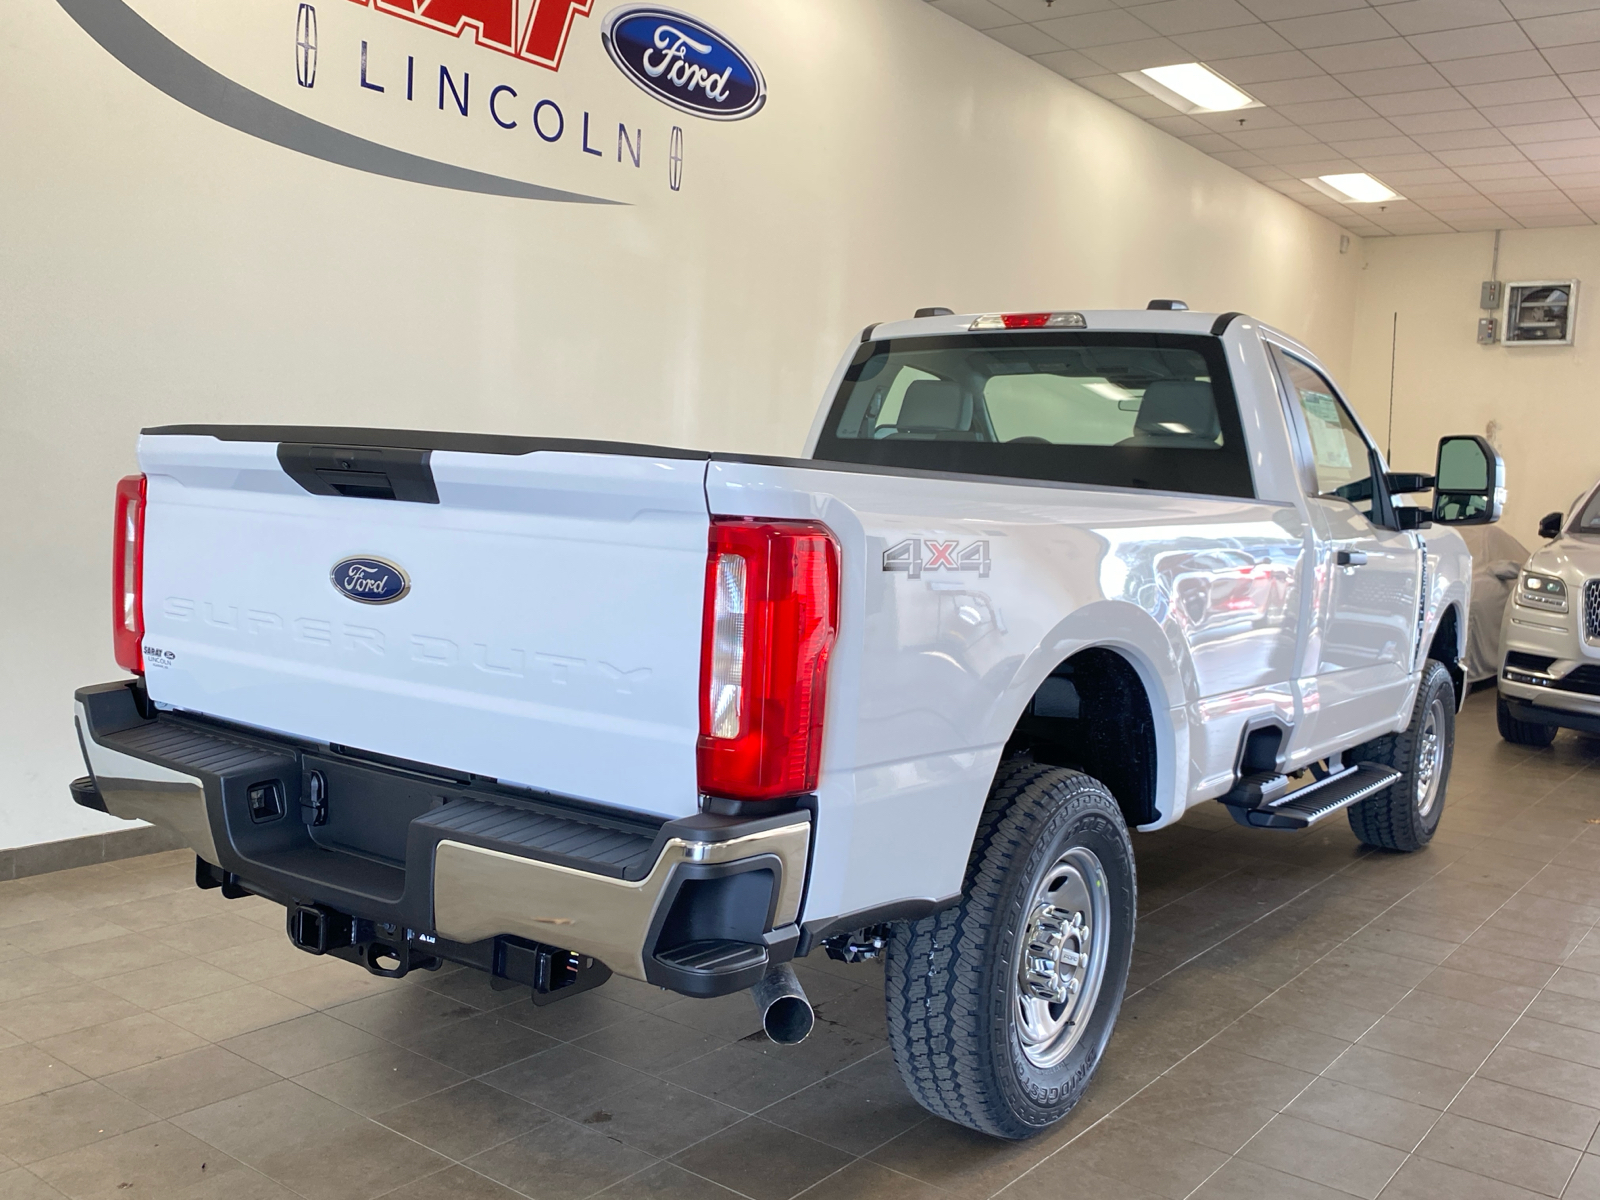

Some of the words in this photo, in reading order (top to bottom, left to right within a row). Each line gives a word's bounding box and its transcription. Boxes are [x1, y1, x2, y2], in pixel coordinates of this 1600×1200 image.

[360, 40, 643, 169] LINCOLN
[643, 24, 733, 103] Ford
[344, 564, 389, 594] Ford
[163, 596, 386, 656] SUPER
[410, 633, 653, 695] DUTY
